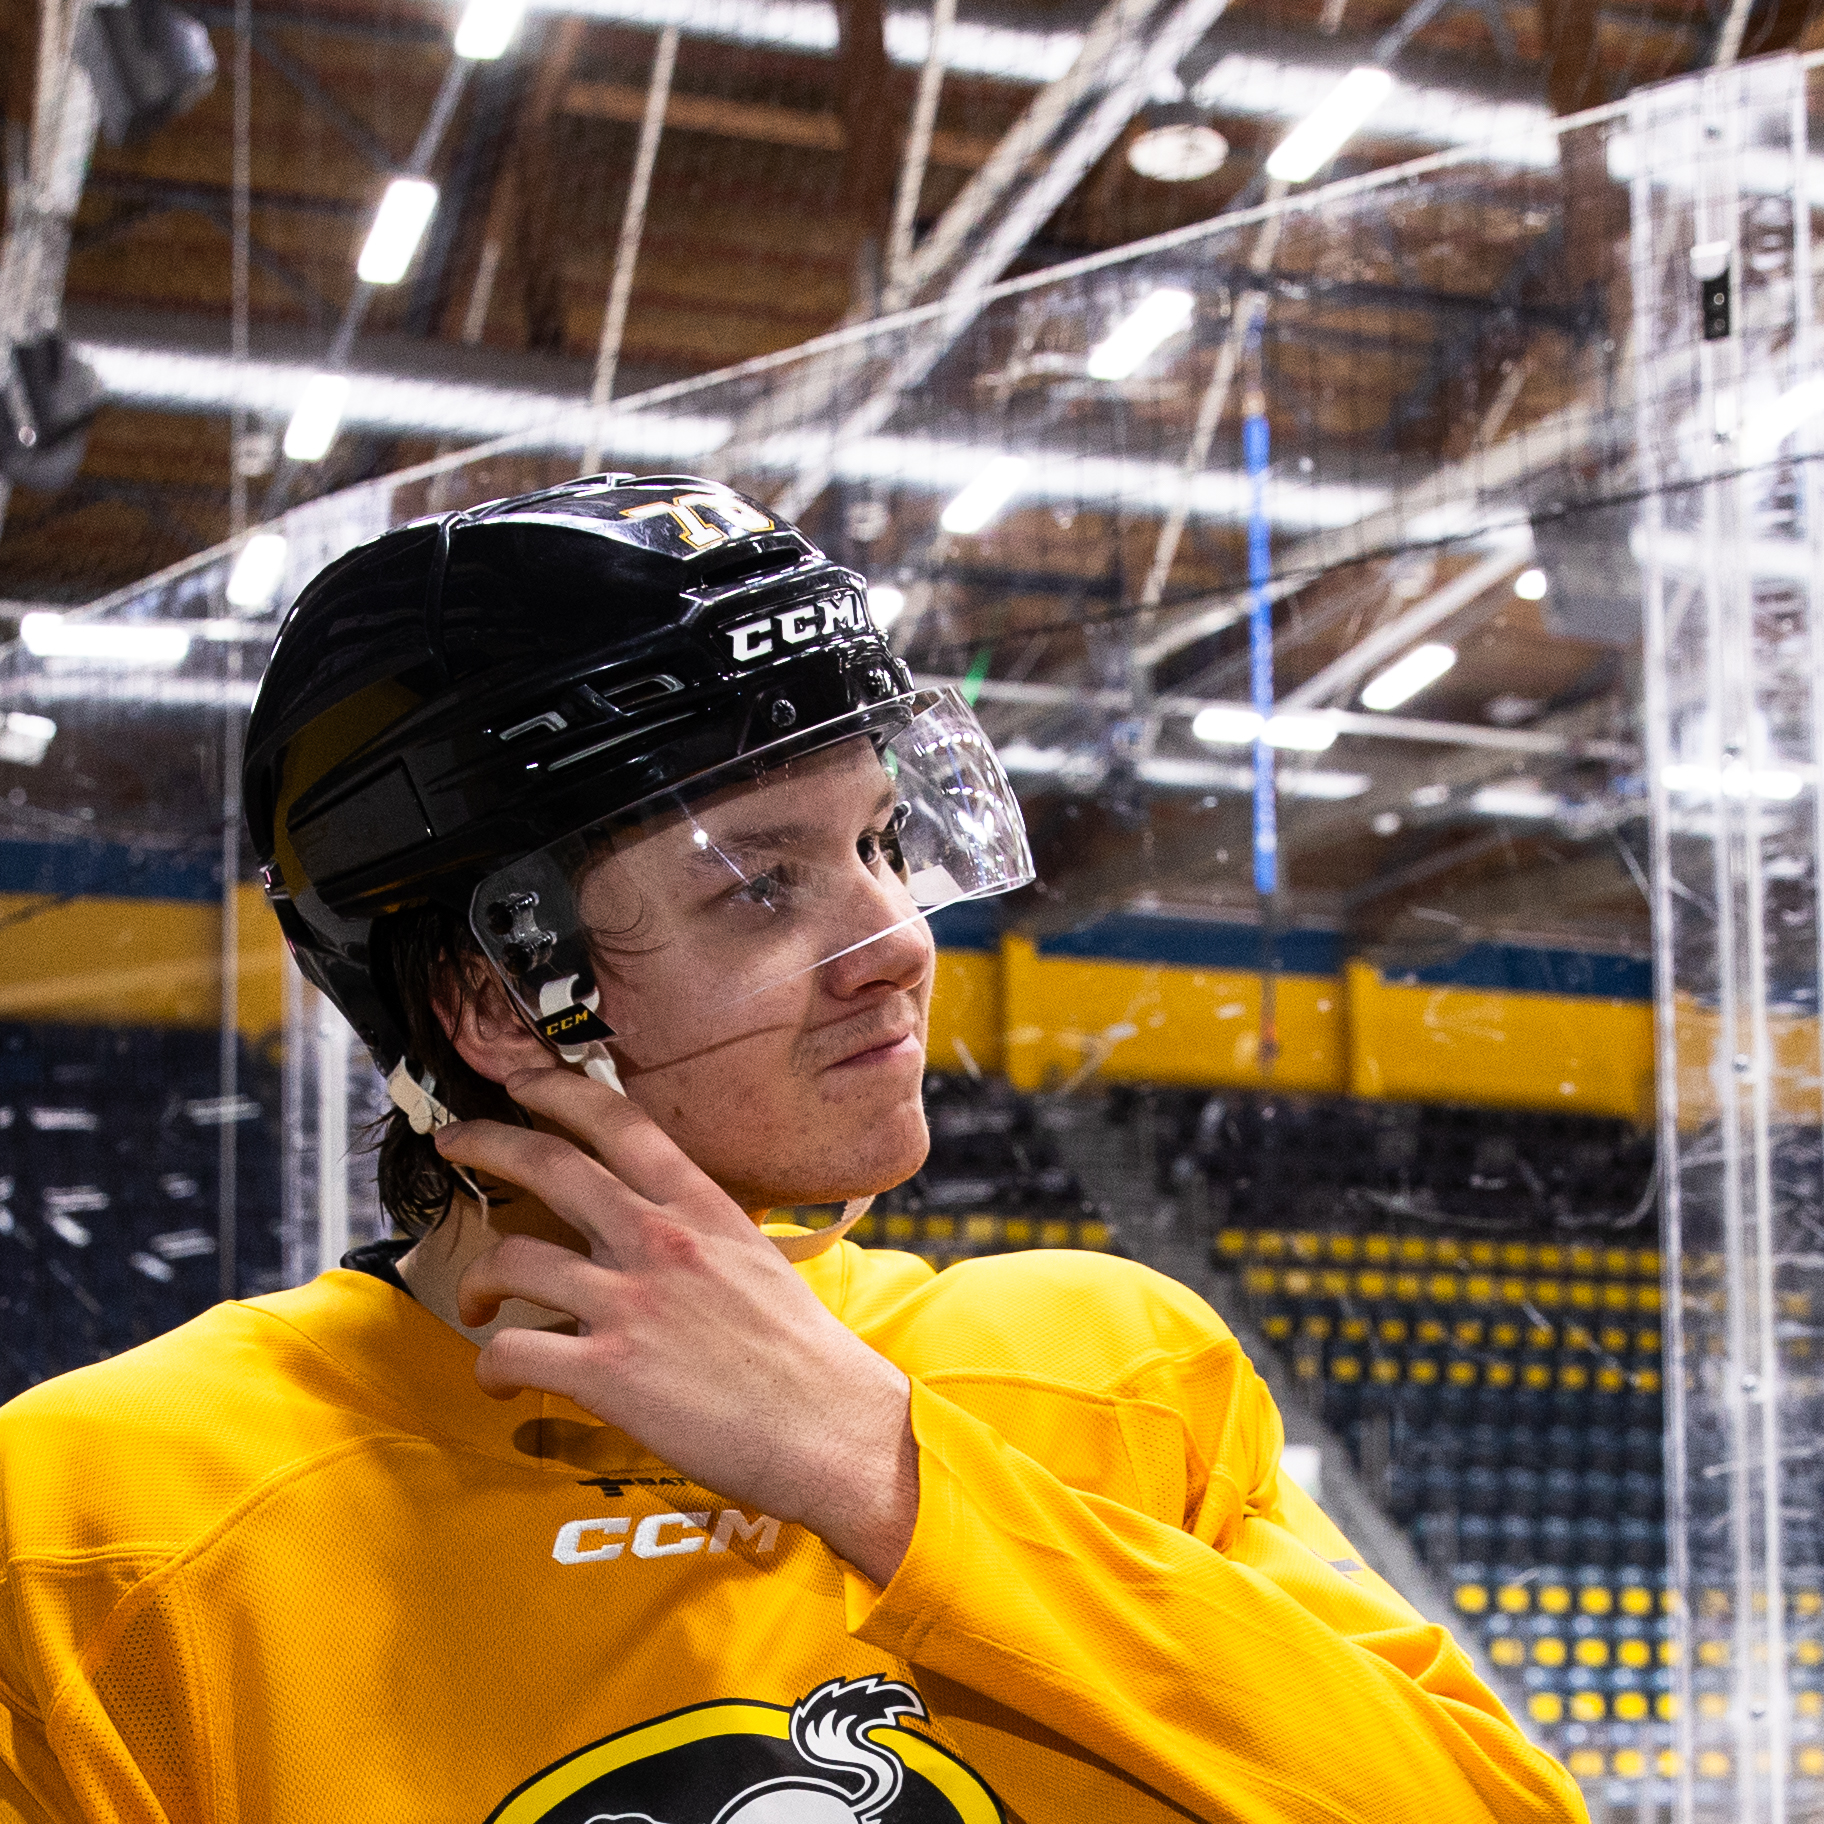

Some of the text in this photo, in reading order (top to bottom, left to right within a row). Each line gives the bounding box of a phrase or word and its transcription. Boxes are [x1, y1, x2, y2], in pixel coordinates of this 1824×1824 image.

[727, 595, 864, 662] CCM
[546, 1009, 588, 1036] CCM
[551, 1508, 782, 1566] CCM
